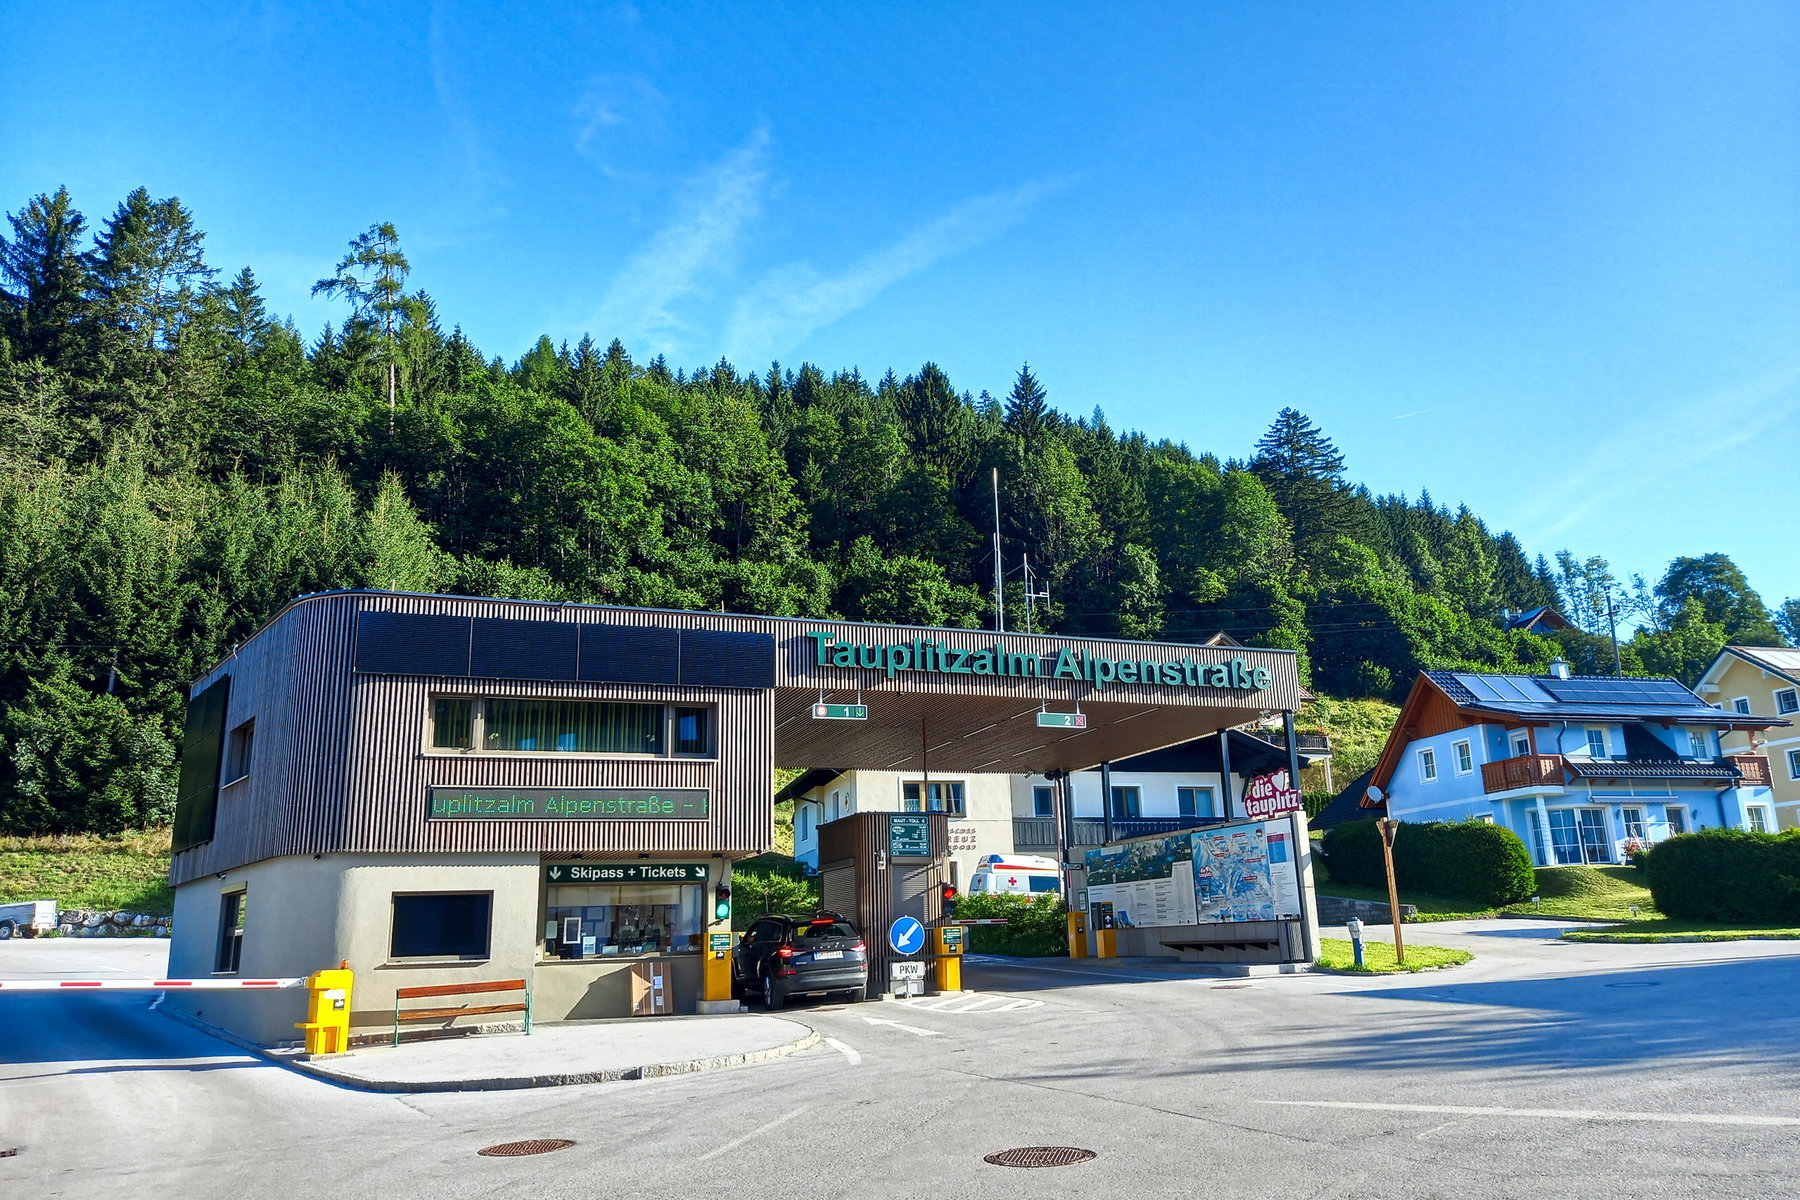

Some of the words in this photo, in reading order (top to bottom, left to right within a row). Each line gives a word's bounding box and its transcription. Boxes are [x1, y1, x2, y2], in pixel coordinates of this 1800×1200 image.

[808, 631, 1041, 679] Tauplitzalm
[1053, 646, 1272, 690] Alpenstraße
[843, 707, 850, 717] 1
[1064, 716, 1071, 726] 2
[1252, 779, 1273, 799] die
[433, 794, 535, 818] uplitzalm
[545, 796, 675, 818] Alpenstraße
[1246, 791, 1298, 816] tauplitz
[570, 866, 624, 881] Skipass
[628, 868, 636, 876] +
[640, 866, 687, 878] Tickets
[899, 964, 919, 974] PKW
